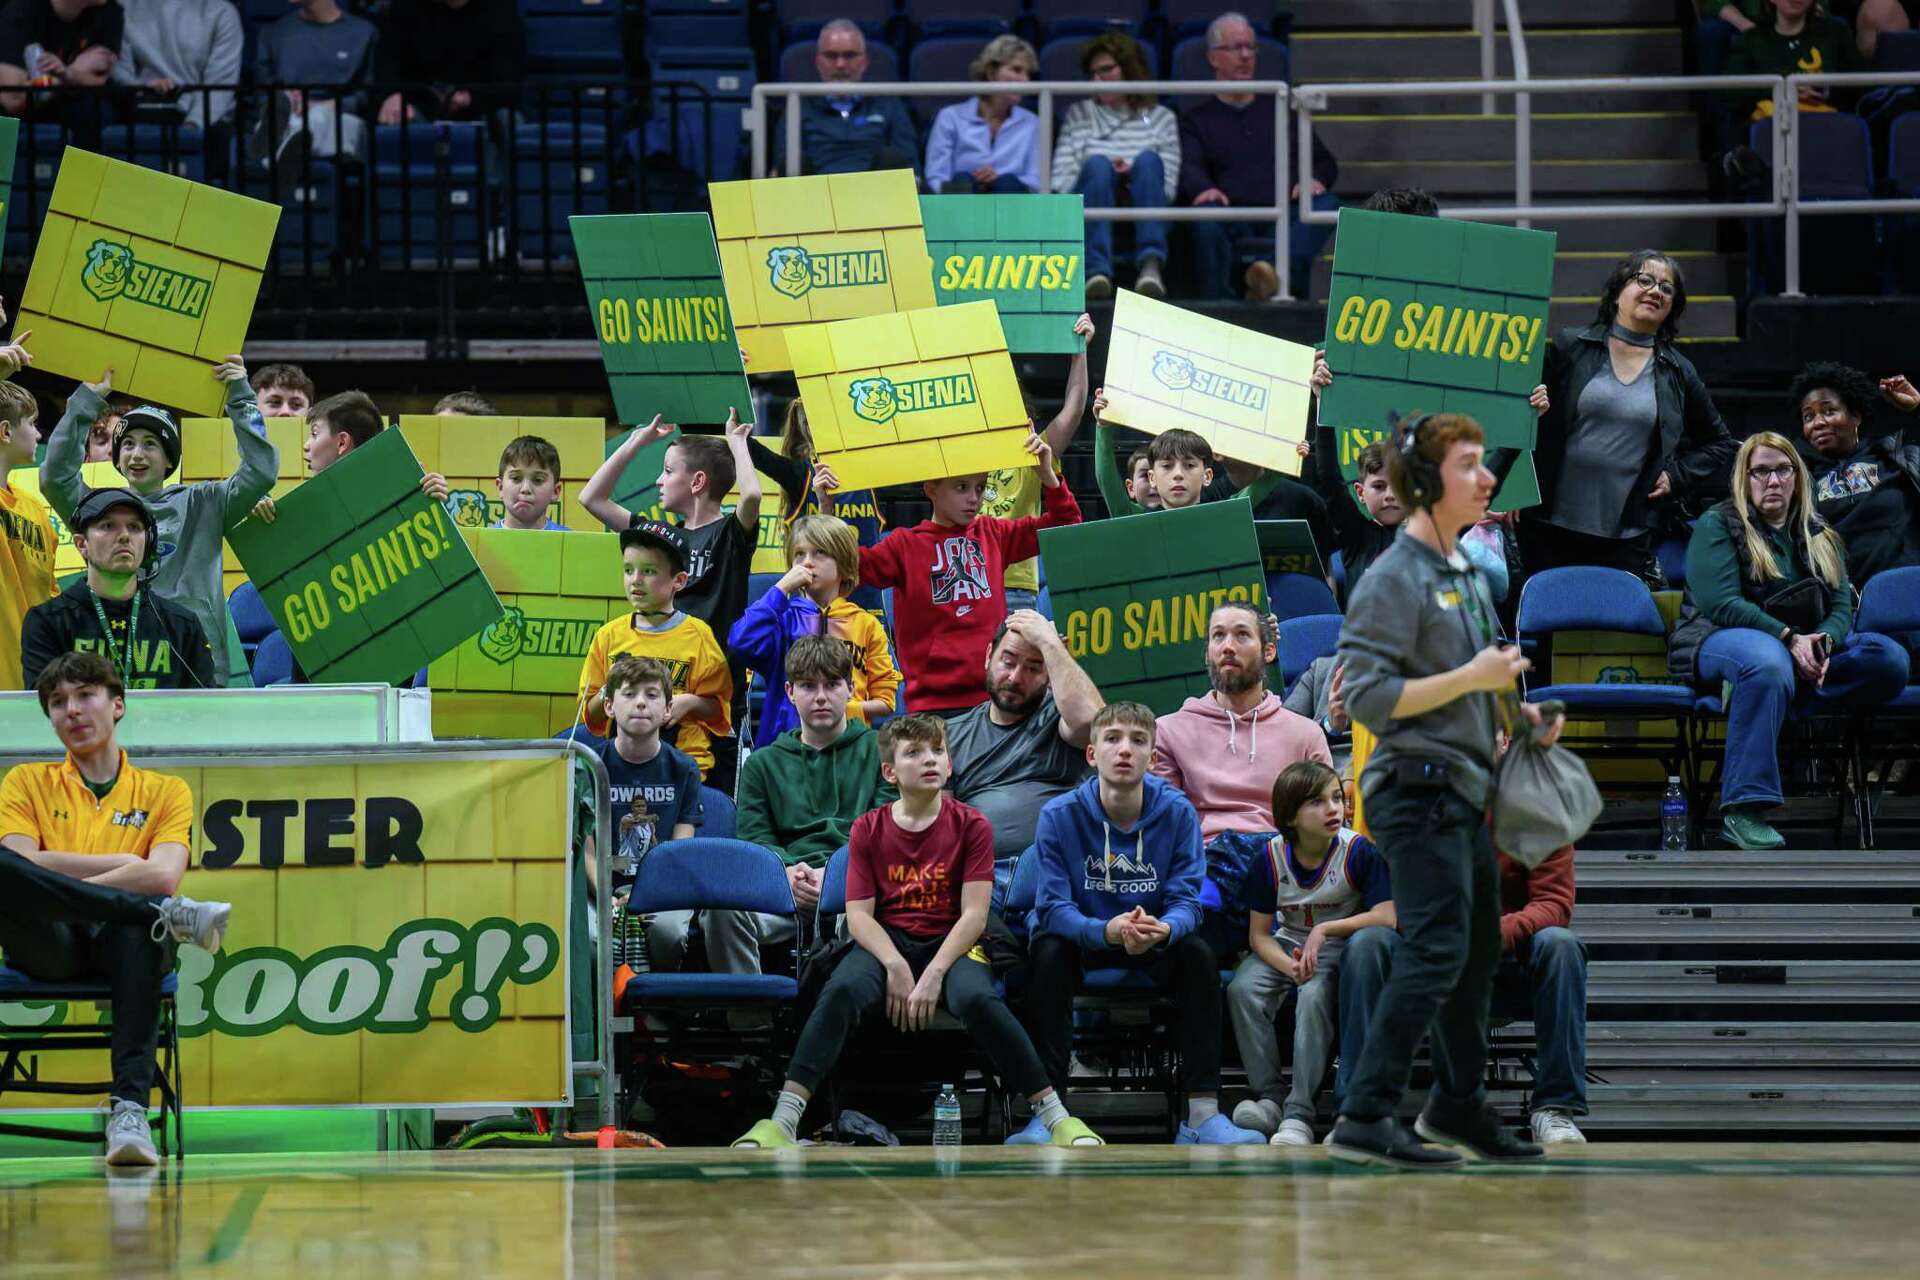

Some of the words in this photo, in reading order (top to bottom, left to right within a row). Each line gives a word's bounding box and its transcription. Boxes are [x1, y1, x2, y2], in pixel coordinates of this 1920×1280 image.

[812, 251, 885, 287] SIENA
[940, 254, 1081, 291] SAINTS!
[124, 264, 208, 316] SIENA
[599, 297, 632, 344] GO
[635, 296, 728, 343] SAINTS!
[1335, 295, 1392, 346] GO
[1394, 302, 1542, 366] SAINTS!
[896, 375, 974, 412] SIENA
[1191, 370, 1266, 410] SIENA
[806, 502, 875, 518] NIANA
[284, 580, 331, 643] GO
[330, 502, 451, 613] SAINTS!
[1067, 606, 1113, 658] GO
[609, 785, 676, 803] DWARDS
[198, 797, 425, 869] STER
[888, 862, 945, 882] MAKE
[1120, 881, 1157, 893] GOOD
